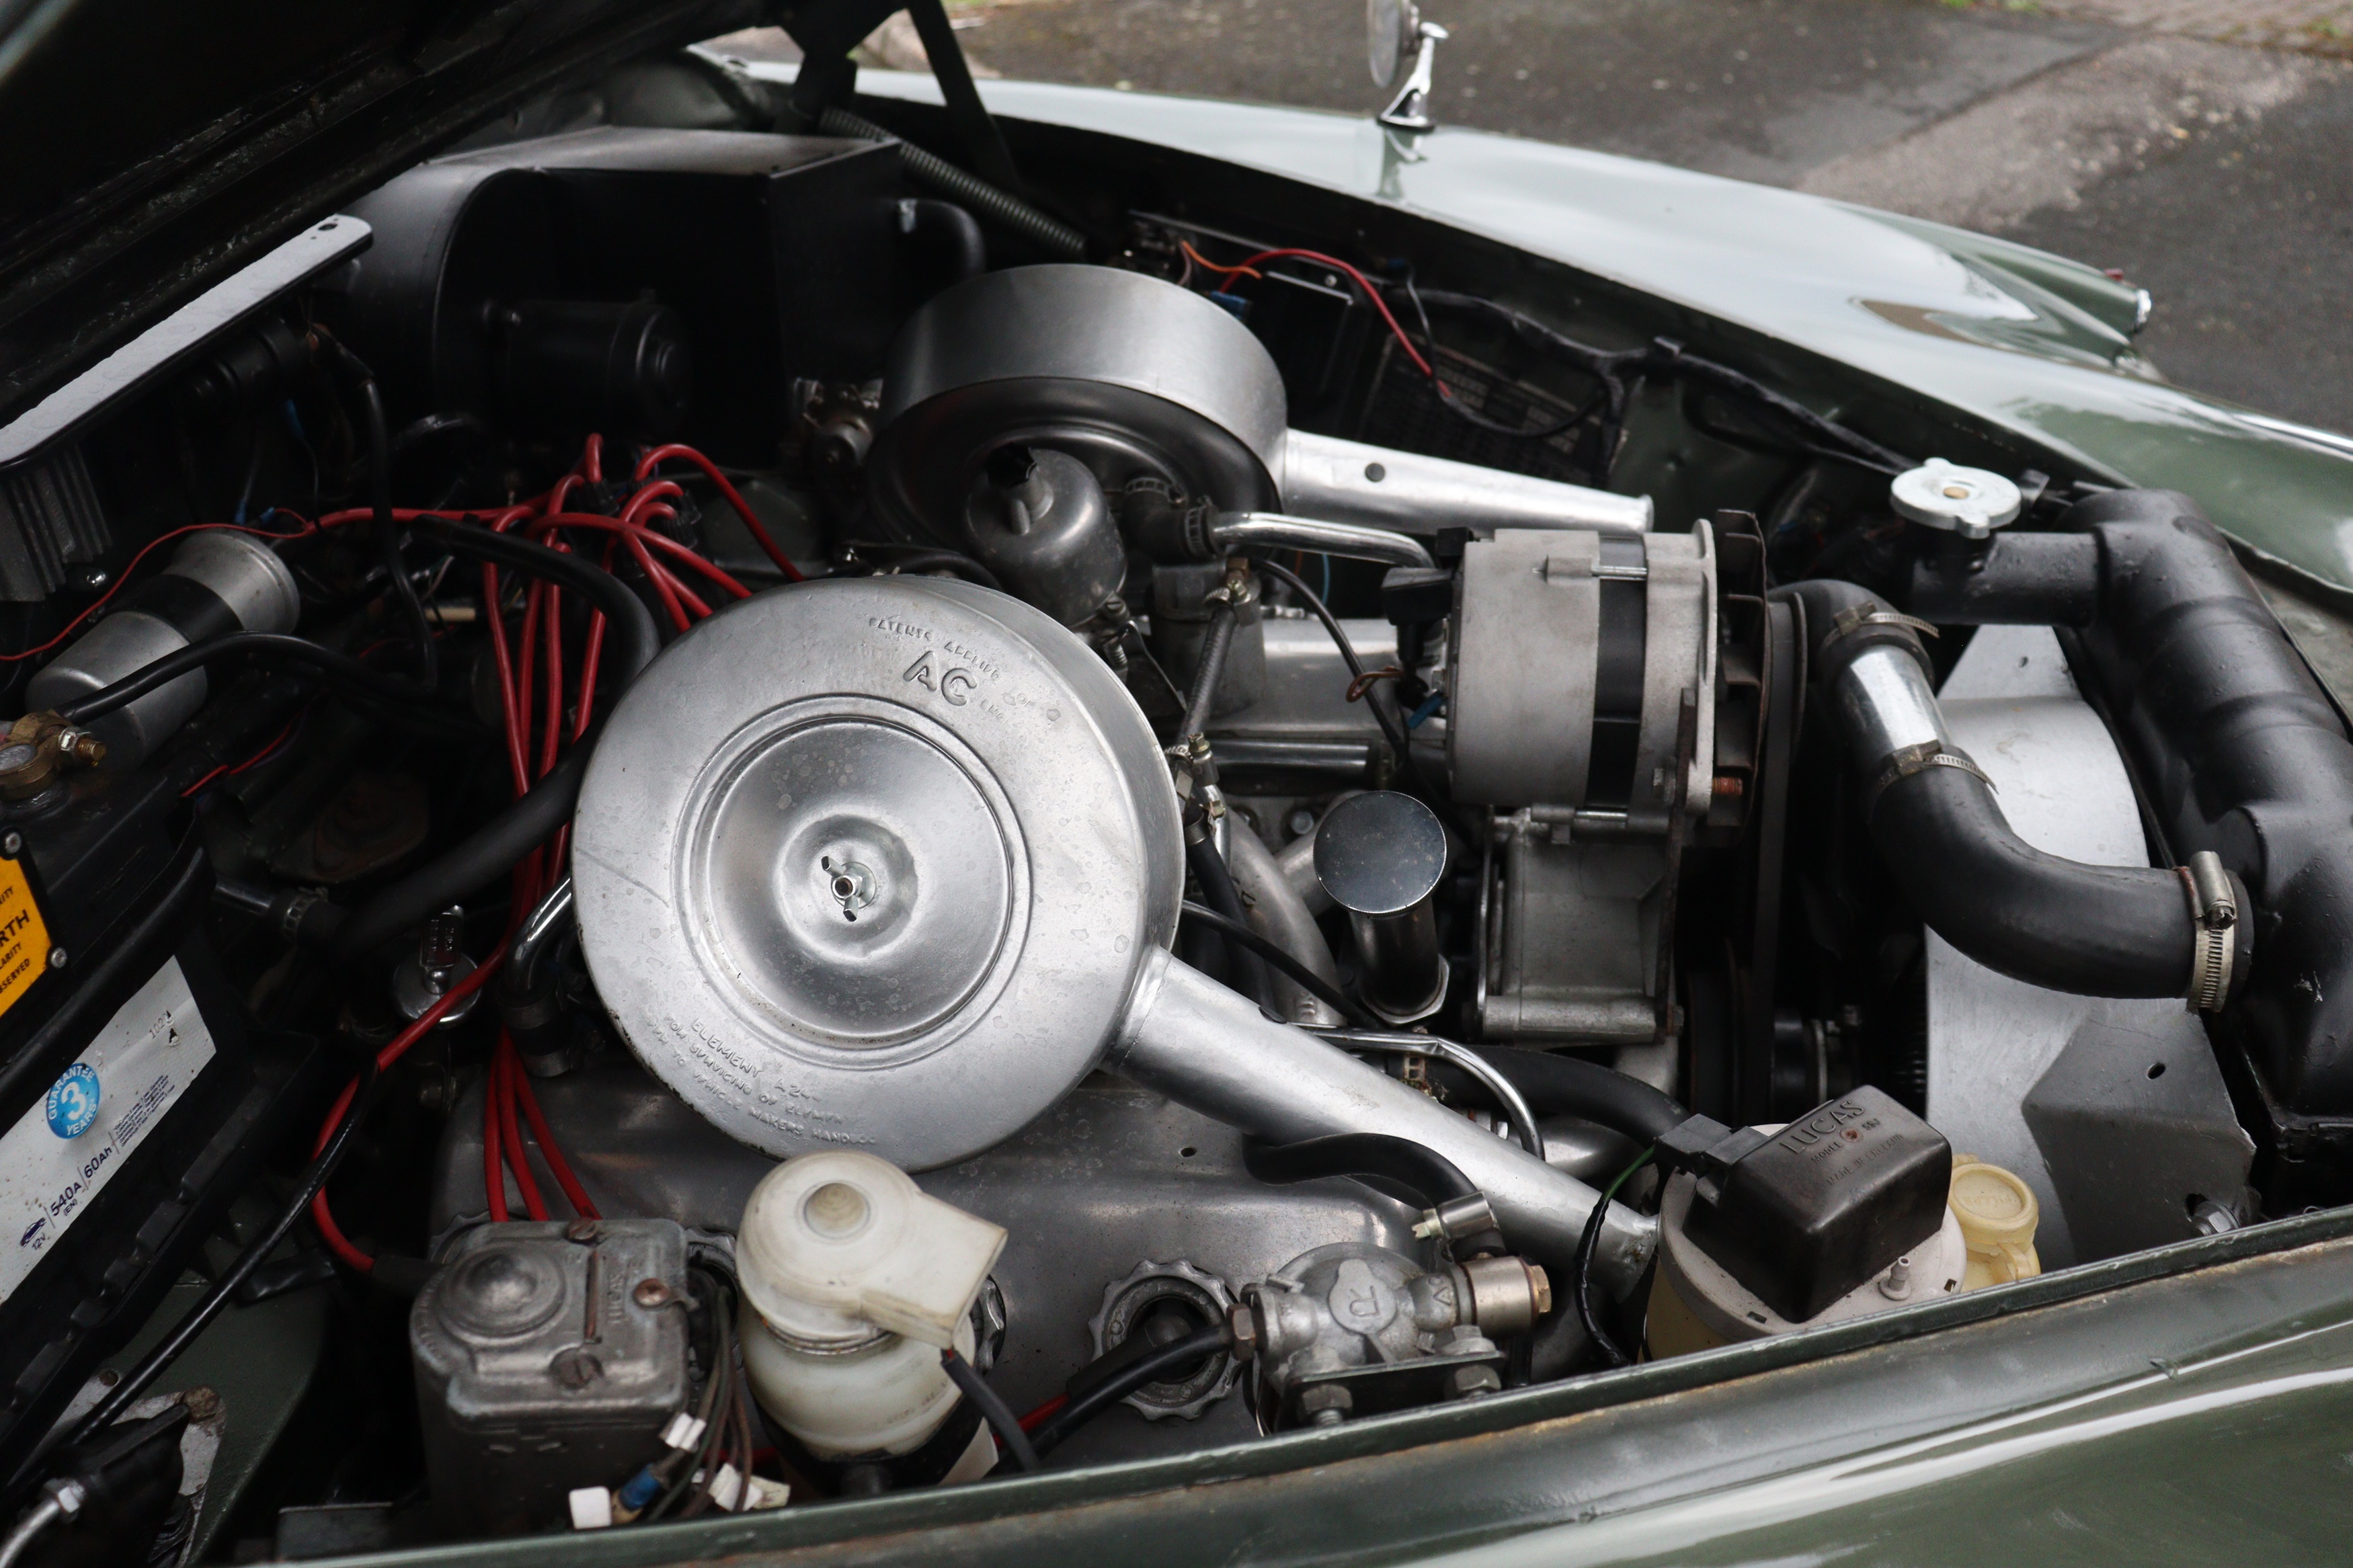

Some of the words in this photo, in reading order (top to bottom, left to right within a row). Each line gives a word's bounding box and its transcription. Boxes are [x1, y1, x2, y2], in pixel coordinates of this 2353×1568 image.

[903, 651, 977, 706] AC
[691, 1018, 764, 1077] ELEMENT
[48, 1065, 94, 1120] GUARANTEE
[61, 1081, 86, 1120] 3
[1780, 1101, 1865, 1154] LUCAS
[1811, 1141, 1842, 1163] MODEL
[50, 1182, 81, 1216] 540A
[84, 1147, 112, 1178] 60Ah
[63, 1198, 77, 1216] (EN)
[32, 1233, 46, 1250] 12V
